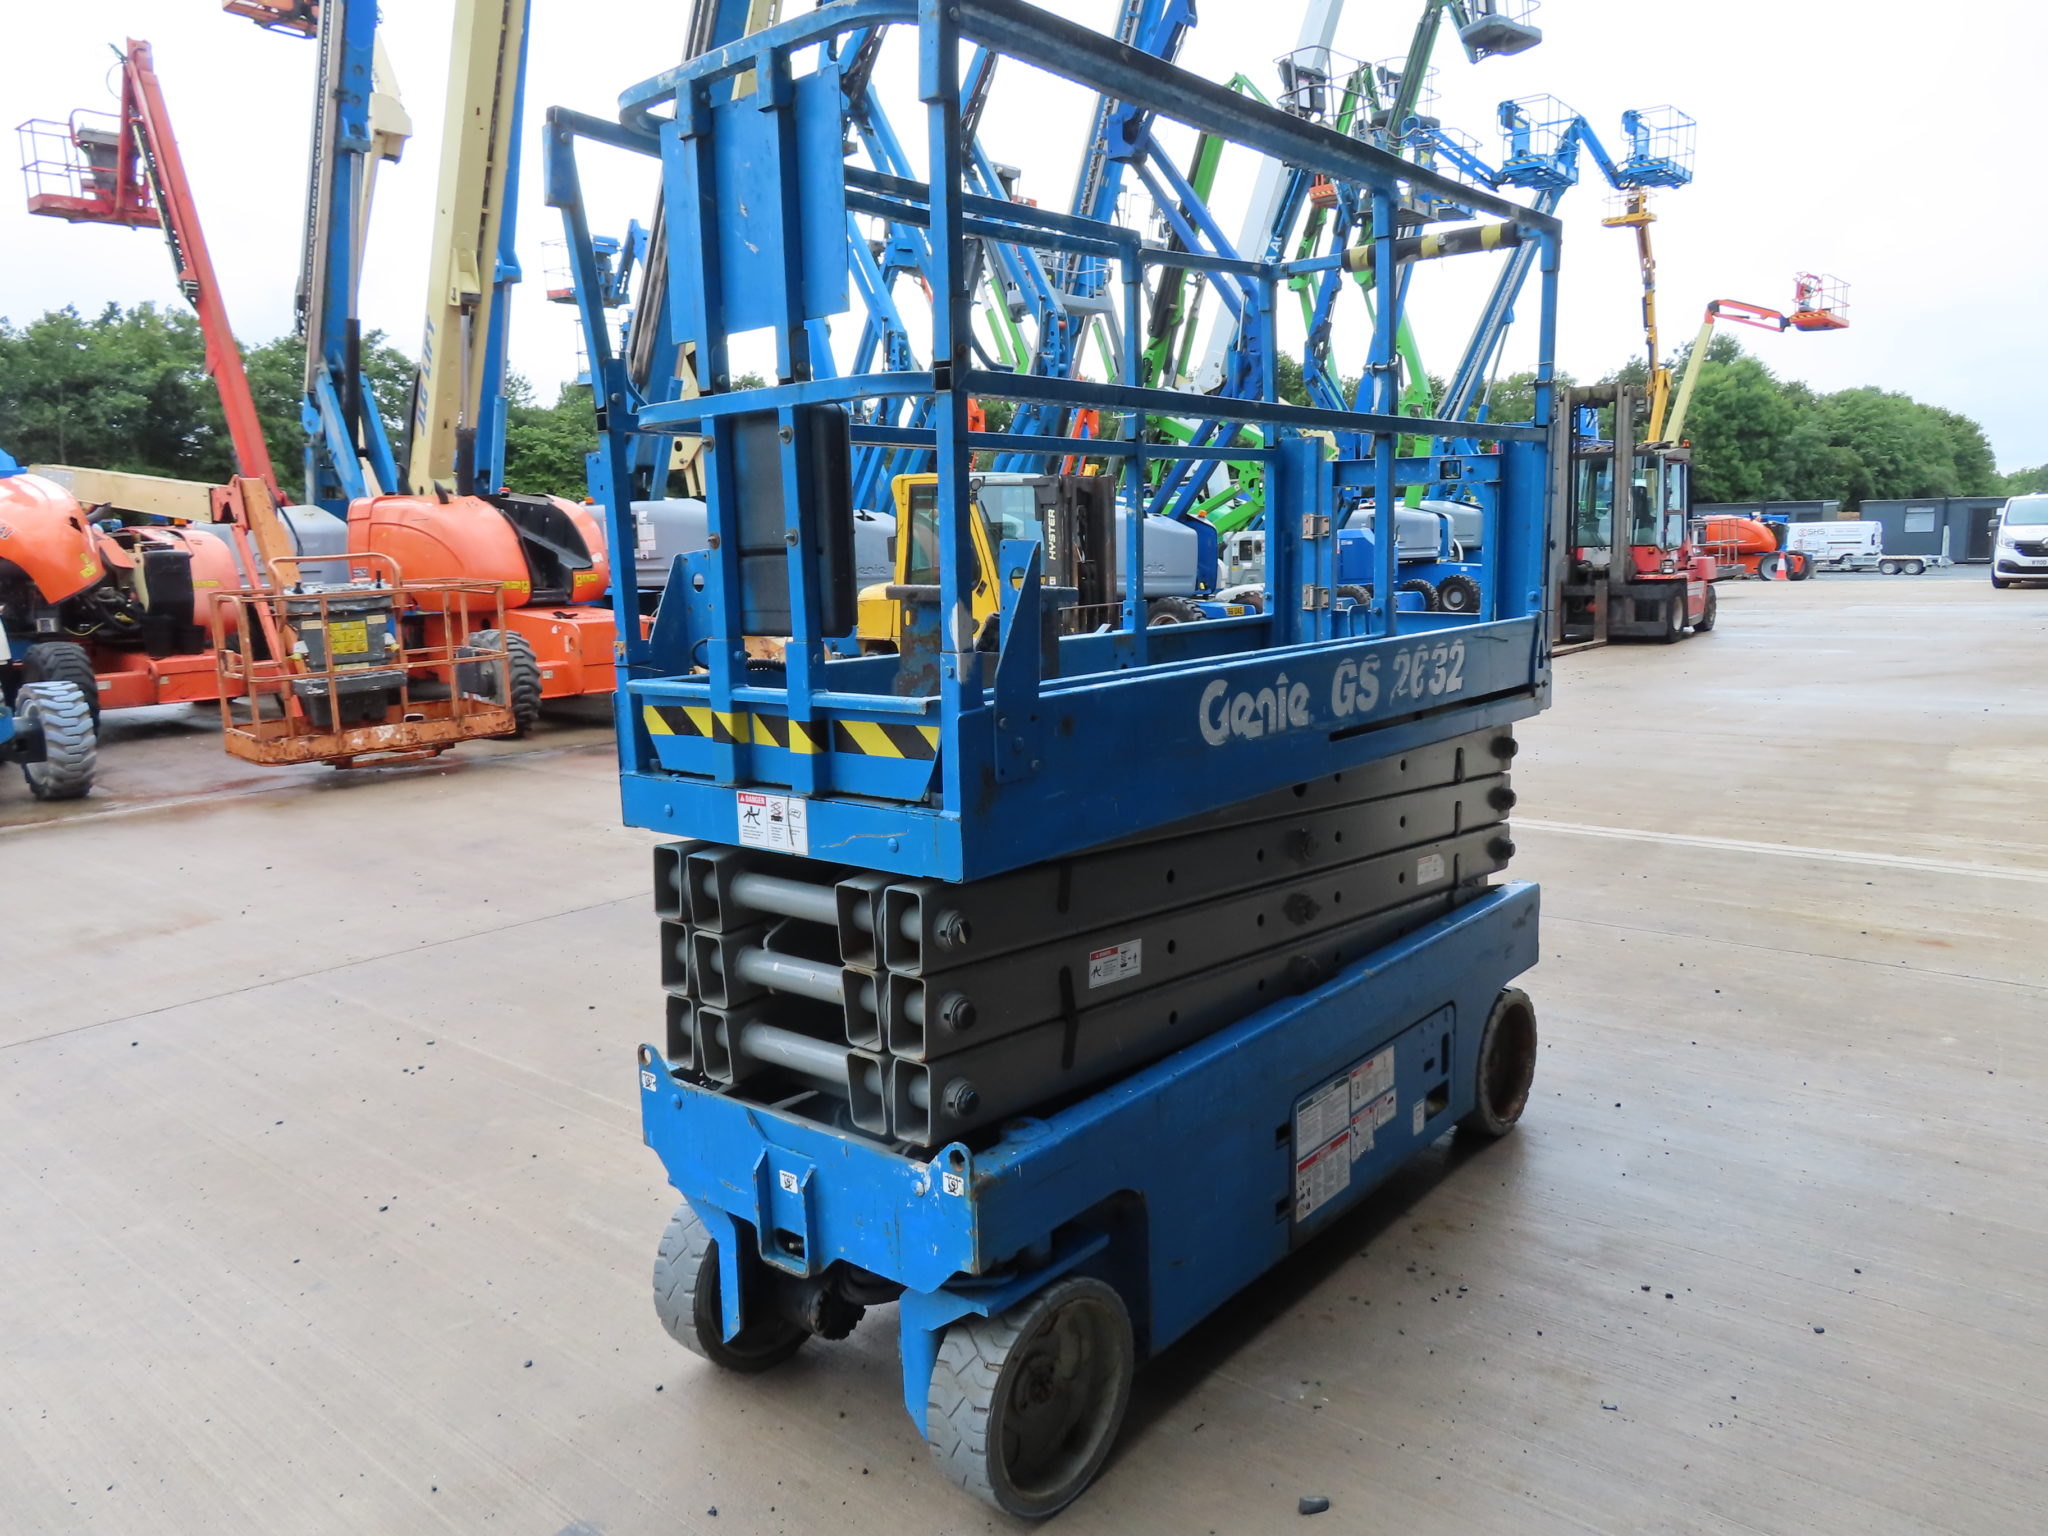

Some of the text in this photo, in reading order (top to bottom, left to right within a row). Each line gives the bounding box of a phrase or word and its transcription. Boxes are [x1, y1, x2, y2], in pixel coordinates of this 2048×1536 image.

[1047, 508, 1057, 561] HYSTER
[1199, 672, 1311, 747] Genie
[1331, 654, 1382, 718] GS
